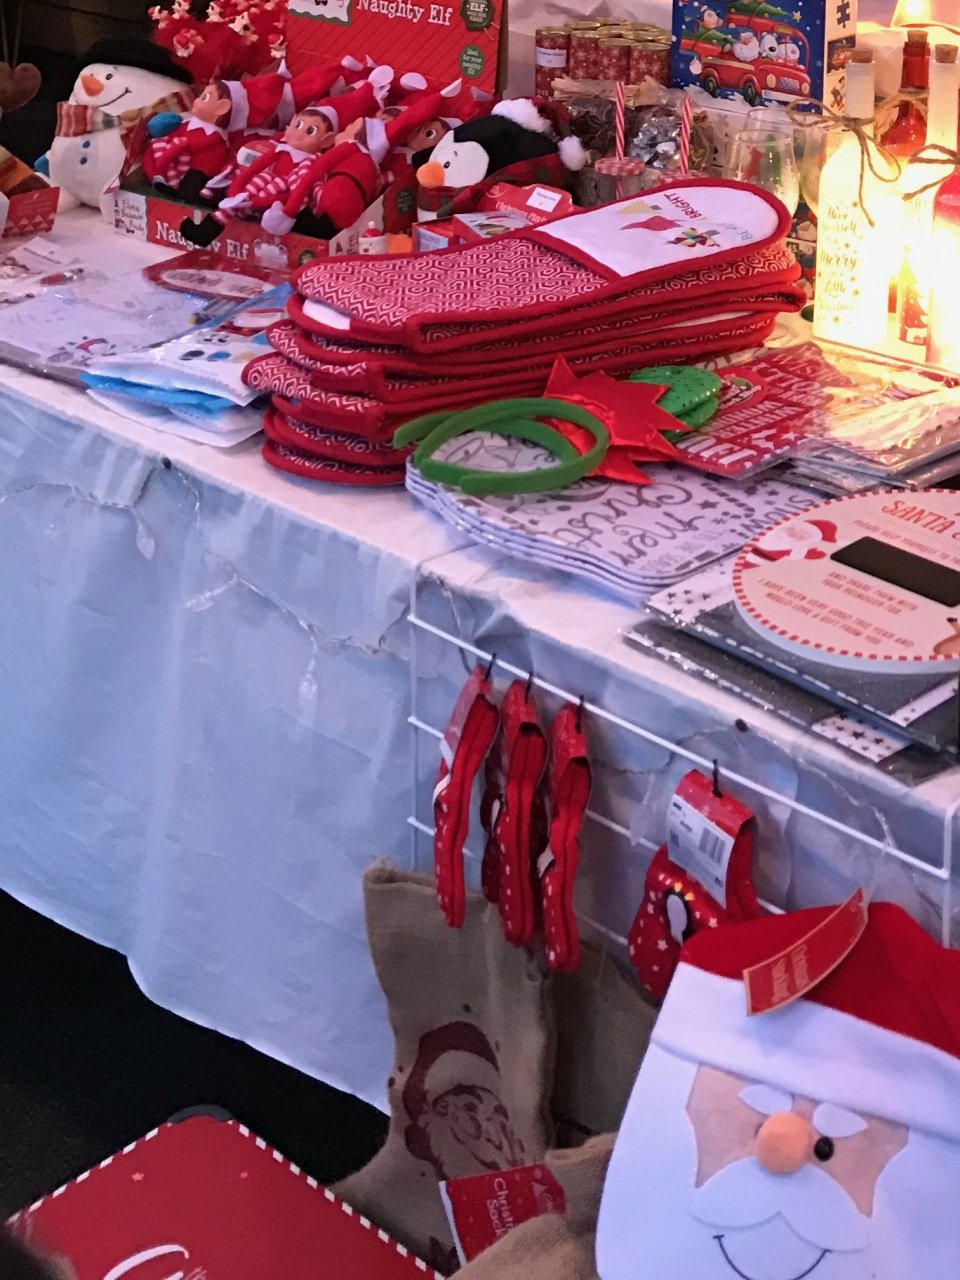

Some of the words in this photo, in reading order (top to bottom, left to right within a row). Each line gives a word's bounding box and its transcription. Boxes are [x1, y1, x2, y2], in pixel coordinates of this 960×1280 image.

[428, 4, 453, 26] Elf
[664, 193, 702, 219] BRIGHT
[226, 239, 250, 260] Elf
[882, 499, 957, 534] SANTA
